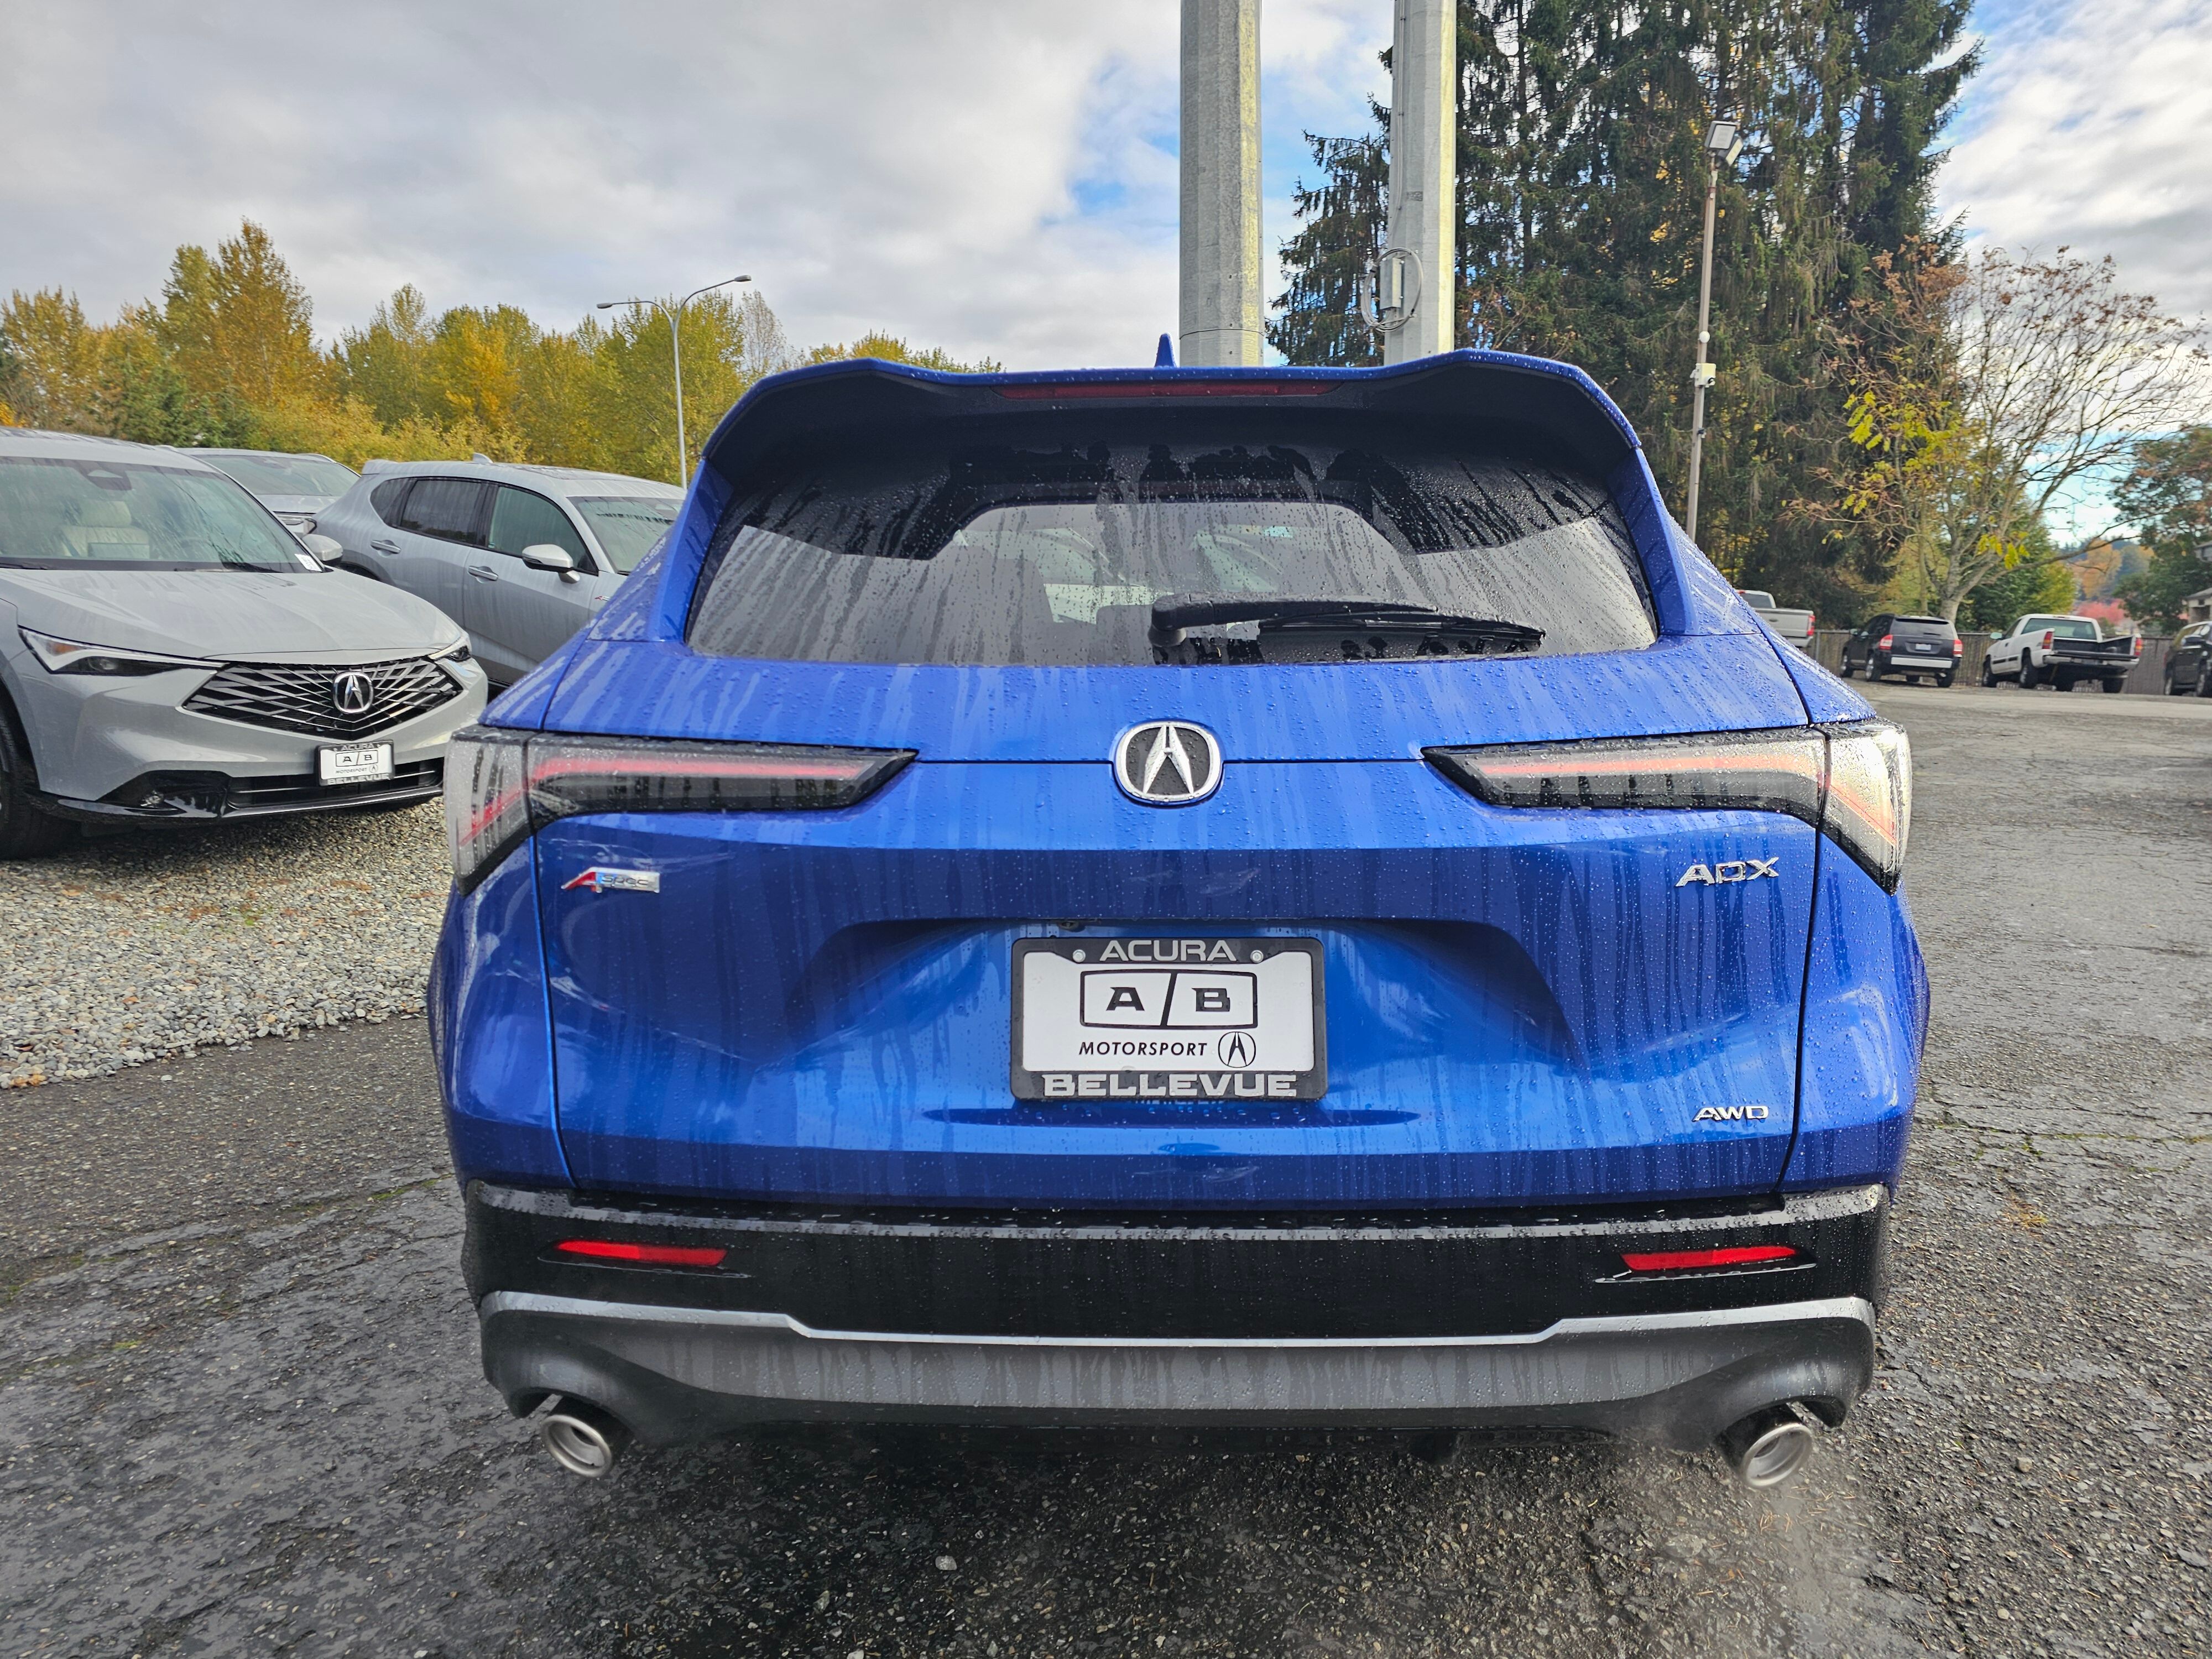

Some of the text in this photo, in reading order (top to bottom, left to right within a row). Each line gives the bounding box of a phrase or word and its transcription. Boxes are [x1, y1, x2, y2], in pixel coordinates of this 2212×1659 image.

[341, 743, 374, 751] ACURA
[327, 774, 389, 785] BELLEVUE
[1675, 857, 1780, 887] ADX
[1100, 940, 1237, 962] ACURA
[1106, 987, 1230, 1012] A B
[1079, 1042, 1207, 1056] MOTORSPORT
[1042, 1074, 1297, 1097] BELLEVUE
[1692, 1105, 1769, 1123] AWD
